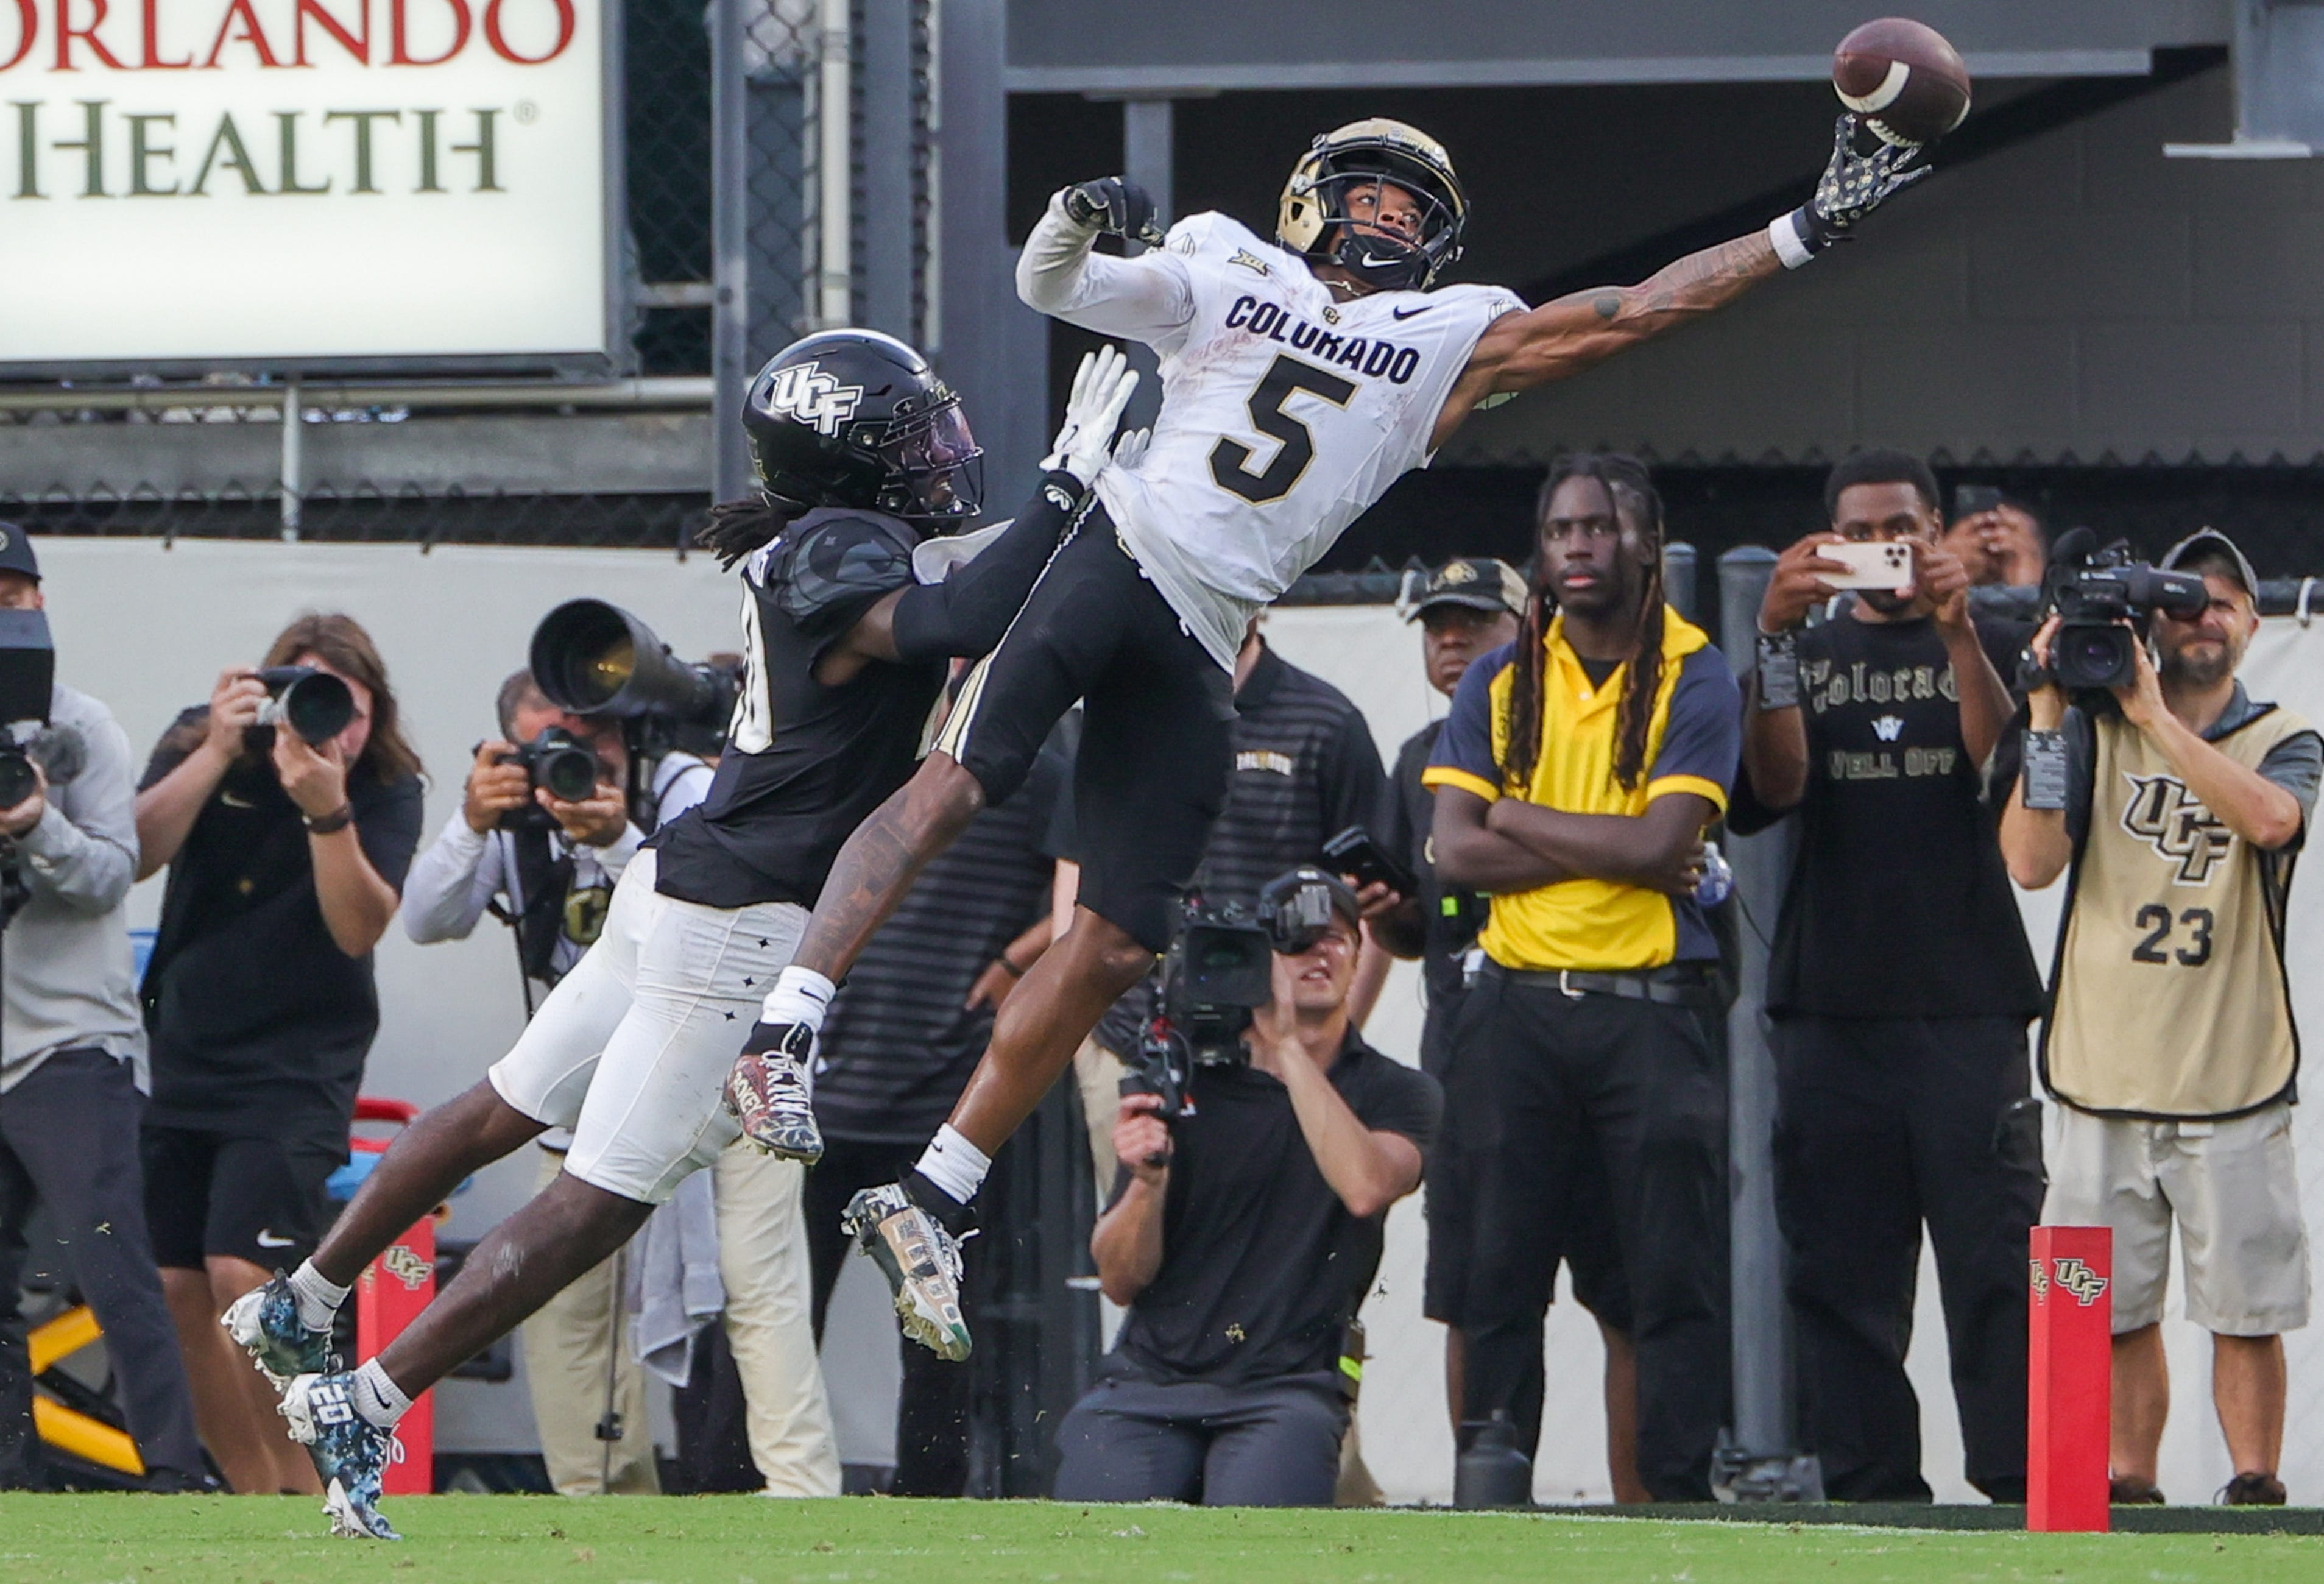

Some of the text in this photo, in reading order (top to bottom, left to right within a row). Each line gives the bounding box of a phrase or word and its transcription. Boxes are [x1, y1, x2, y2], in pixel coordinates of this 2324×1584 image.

[1225, 295, 1421, 385] COLORADO
[769, 361, 864, 438] UCF
[1205, 350, 1363, 507] 5
[2120, 771, 2239, 887] UCF
[2132, 903, 2213, 967] 23
[383, 1245, 434, 1290] UCF
[2054, 1258, 2108, 1306] UCF
[308, 1383, 353, 1424] 20
